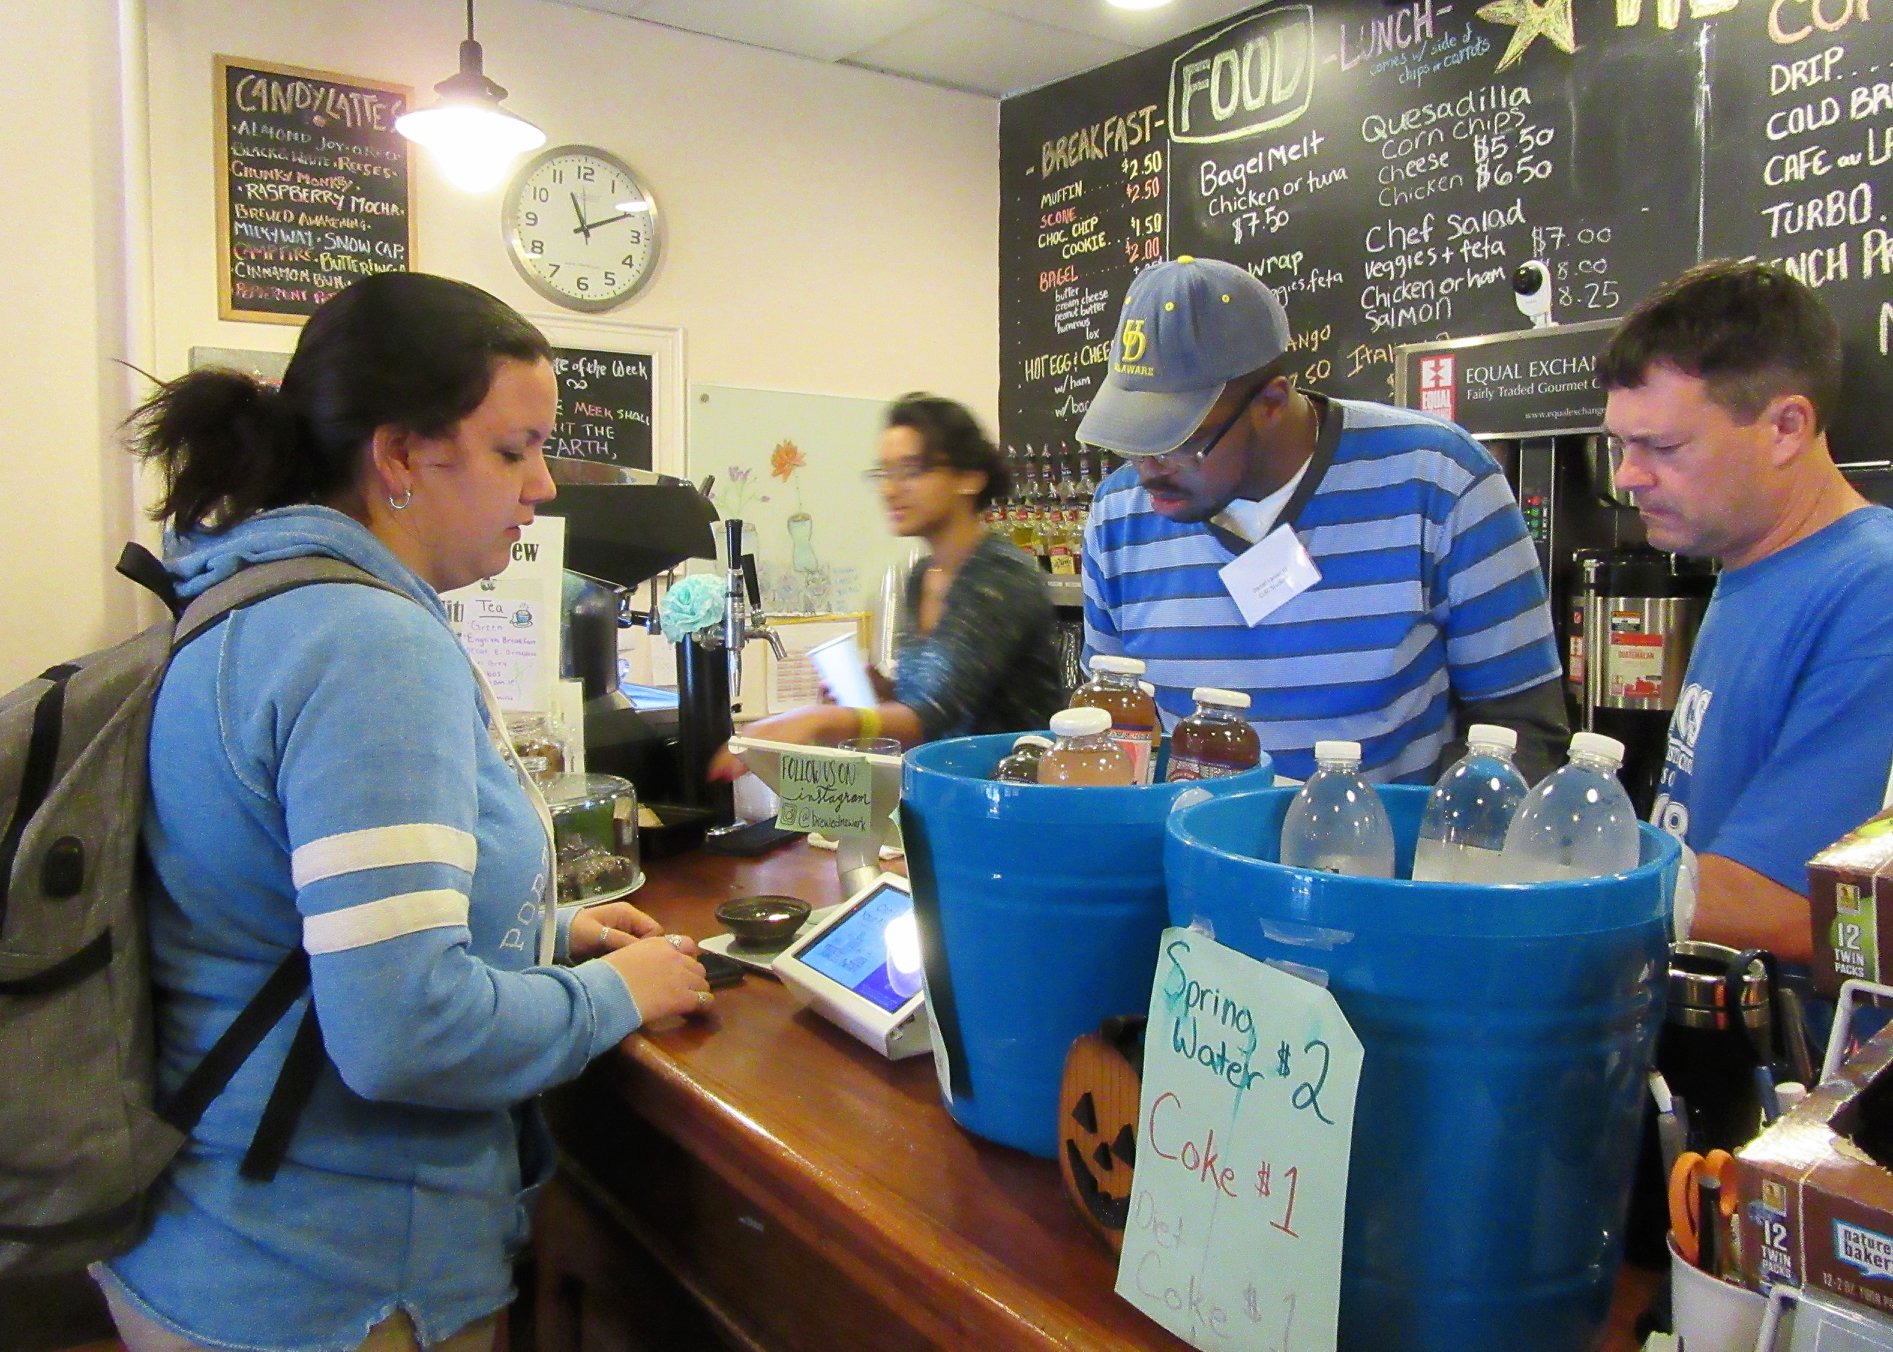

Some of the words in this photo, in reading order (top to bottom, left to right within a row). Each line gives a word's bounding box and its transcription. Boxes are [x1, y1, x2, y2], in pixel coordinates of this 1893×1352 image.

[1181, 21, 1307, 132] FOOD
[1399, 64, 1430, 88] chips
[1362, 85, 1531, 142] Quesadilla
[1766, 97, 1840, 140] COLD
[1850, 83, 1893, 120] BR
[1474, 125, 1554, 163] $5.50
[577, 166, 595, 182] 12
[1121, 151, 1162, 180] $2.50
[1200, 152, 1263, 196] Bagel
[1268, 130, 1324, 171] Melt
[1476, 155, 1553, 192] $6.50
[1763, 146, 1833, 186] CAFE
[553, 169, 562, 184] 11
[245, 183, 344, 211] RASPBERRY
[533, 186, 549, 203] 10
[1126, 177, 1160, 203] $2.50
[1209, 186, 1279, 216] Chicken
[1283, 176, 1302, 196] or
[1307, 167, 1348, 193] tuna
[525, 211, 538, 226] 9
[1040, 206, 1077, 228] SCONE
[1072, 217, 1099, 236] CHIP
[1131, 213, 1162, 236] $1.50
[1231, 205, 1289, 245] $7.50
[324, 232, 370, 253] SNOW
[630, 230, 641, 244] 3
[1365, 212, 1434, 252] Chef
[1532, 226, 1612, 257] $7.00
[531, 240, 544, 254] 8
[1125, 237, 1160, 263] $2.00
[1459, 235, 1506, 263] feta
[235, 262, 310, 282] CINNAMON
[549, 263, 560, 278] 7
[622, 255, 633, 268] 4
[577, 276, 589, 291] 6
[604, 271, 615, 287] 5
[1039, 265, 1079, 292] BAGEL
[1439, 276, 1463, 295] or
[1467, 266, 1506, 289] ham
[1055, 286, 1079, 302] butter
[1055, 299, 1079, 312] cream
[1080, 288, 1109, 305] cheese
[1055, 309, 1079, 327] peanut
[1080, 301, 1107, 316] butter
[1086, 328, 1100, 340] lox
[572, 357, 587, 377] of
[612, 360, 648, 380] Week
[1024, 354, 1049, 382] HOT
[1049, 353, 1072, 376] EGG
[1080, 340, 1114, 366] CHEE
[1466, 363, 1522, 386] EQUAL
[1467, 387, 1495, 402] Fairly
[1499, 383, 1535, 398] Traded
[1537, 379, 1588, 394] Gourmet
[574, 402, 614, 421] MEEK
[581, 423, 615, 439] THE
[475, 600, 504, 613] Tea
[471, 620, 503, 631] Green
[782, 785, 870, 813] instagram
[1838, 922, 1861, 950] 12
[1835, 947, 1865, 967] TWIN
[1835, 961, 1865, 978] PACKS
[1165, 940, 1258, 1052] Spring
[1173, 1016, 1264, 1090] Water
[1148, 1092, 1237, 1198] Coke
[1255, 1161, 1300, 1238] $1
[1763, 1219, 1787, 1251] 12
[1843, 1228, 1891, 1256] nature
[1761, 1244, 1791, 1268] TWIN
[1762, 1259, 1792, 1279] PACKS
[1135, 1250, 1234, 1340] Coke
